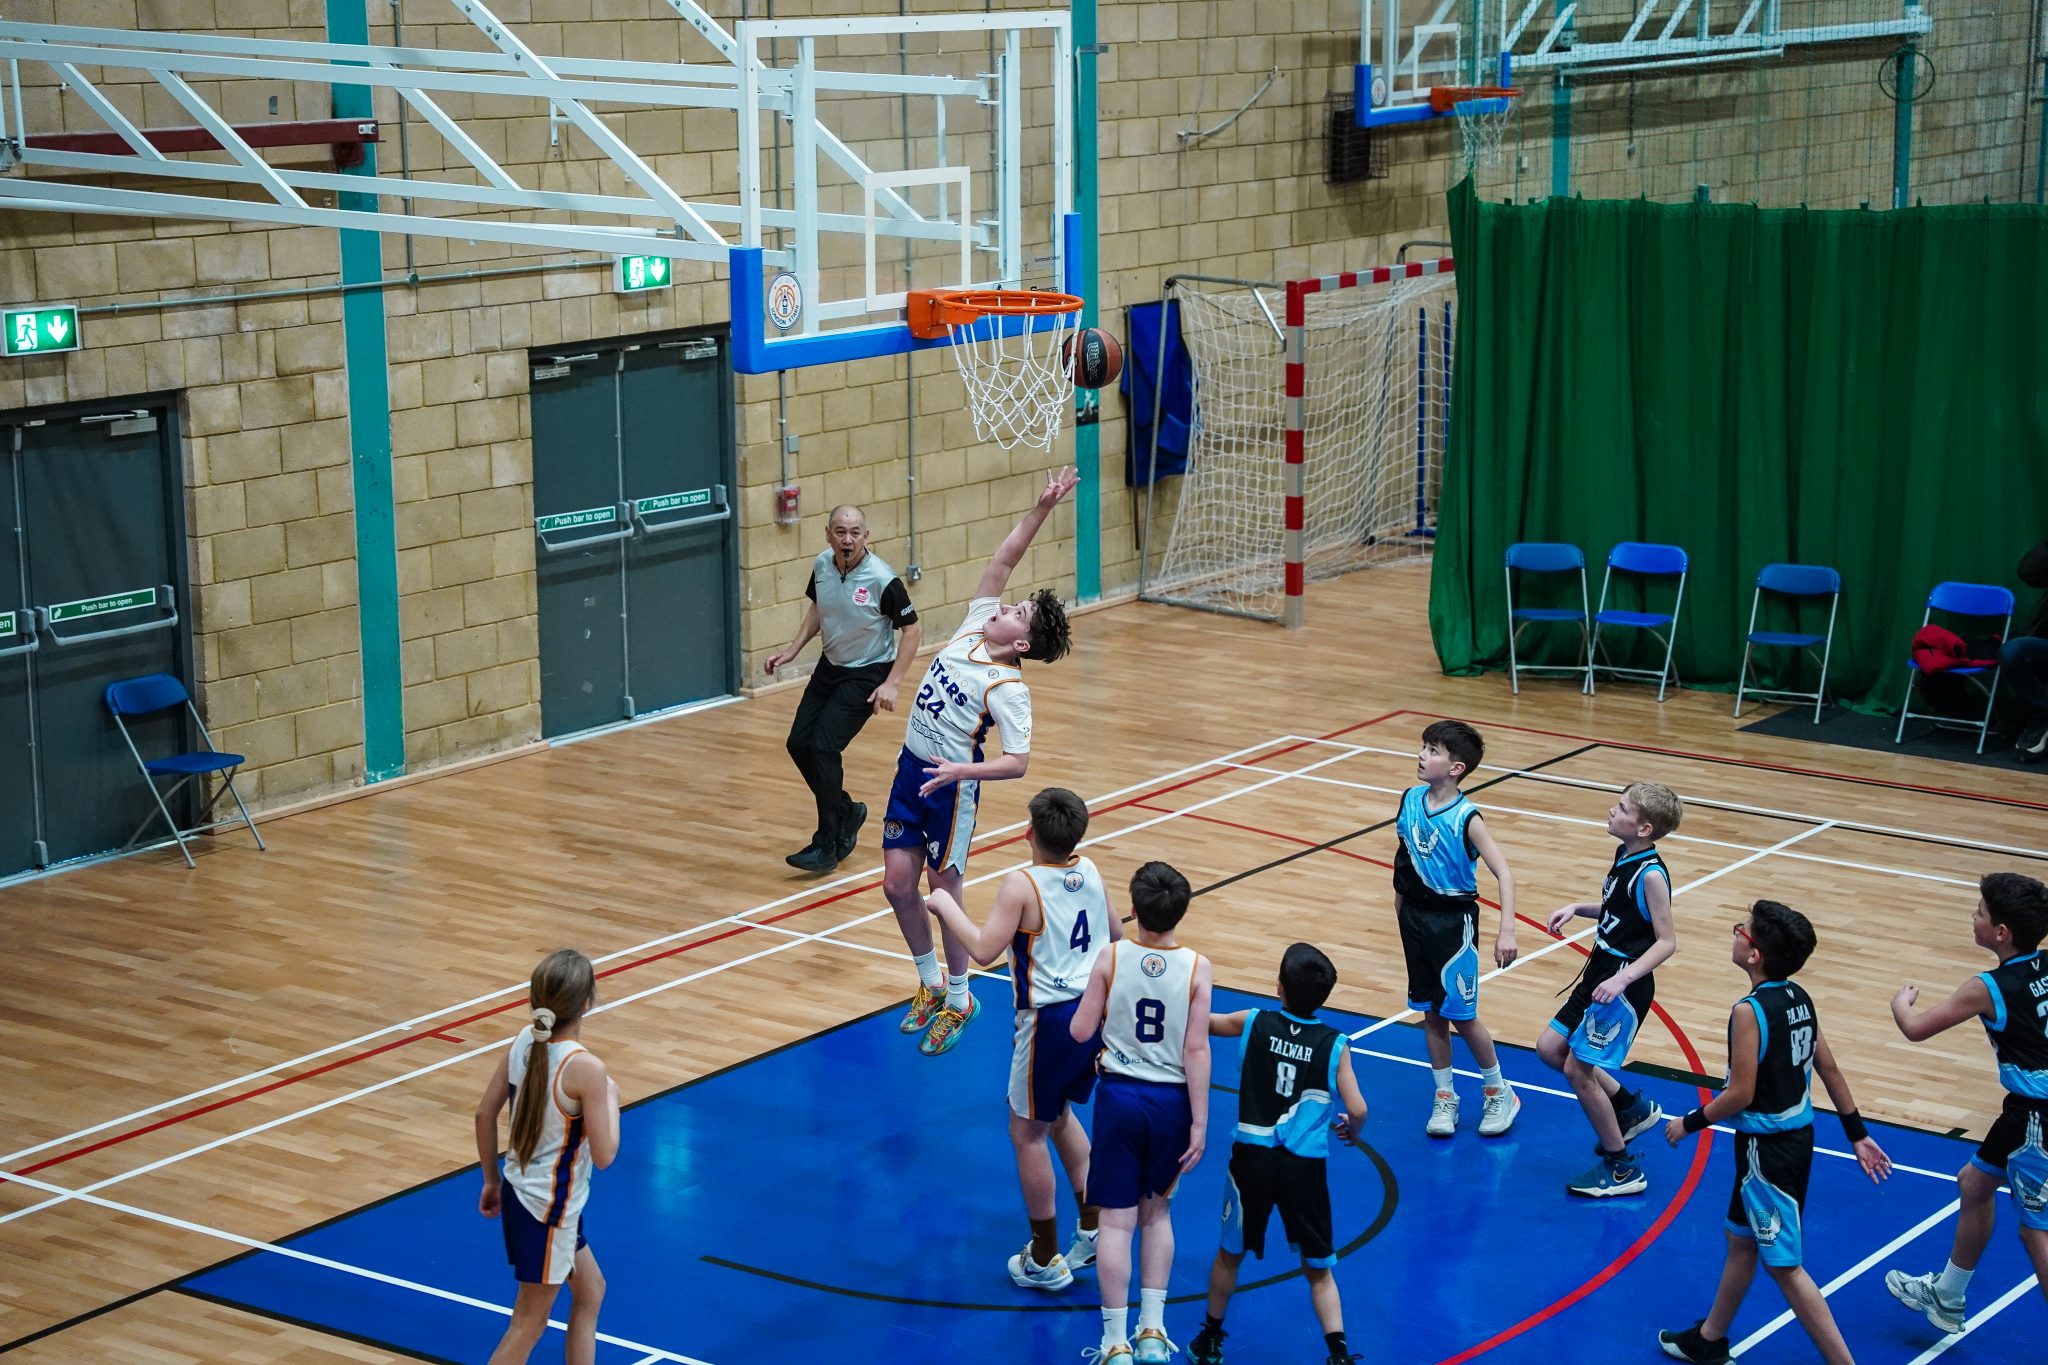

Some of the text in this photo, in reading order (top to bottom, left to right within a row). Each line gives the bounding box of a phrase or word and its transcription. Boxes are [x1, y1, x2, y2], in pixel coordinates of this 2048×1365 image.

[653, 499, 669, 508] Push
[670, 497, 680, 505] bar
[690, 493, 706, 502] open
[554, 517, 571, 526] Push
[573, 515, 584, 523] bar
[594, 511, 610, 520] open
[81, 604, 97, 612] Push
[98, 602, 108, 610] bar
[117, 598, 133, 607] open
[916, 683, 945, 720] 24
[1070, 909, 1091, 953] 4
[1135, 997, 1166, 1043] 8
[1269, 1035, 1313, 1062] TALWAR
[1275, 1061, 1297, 1098] 8
